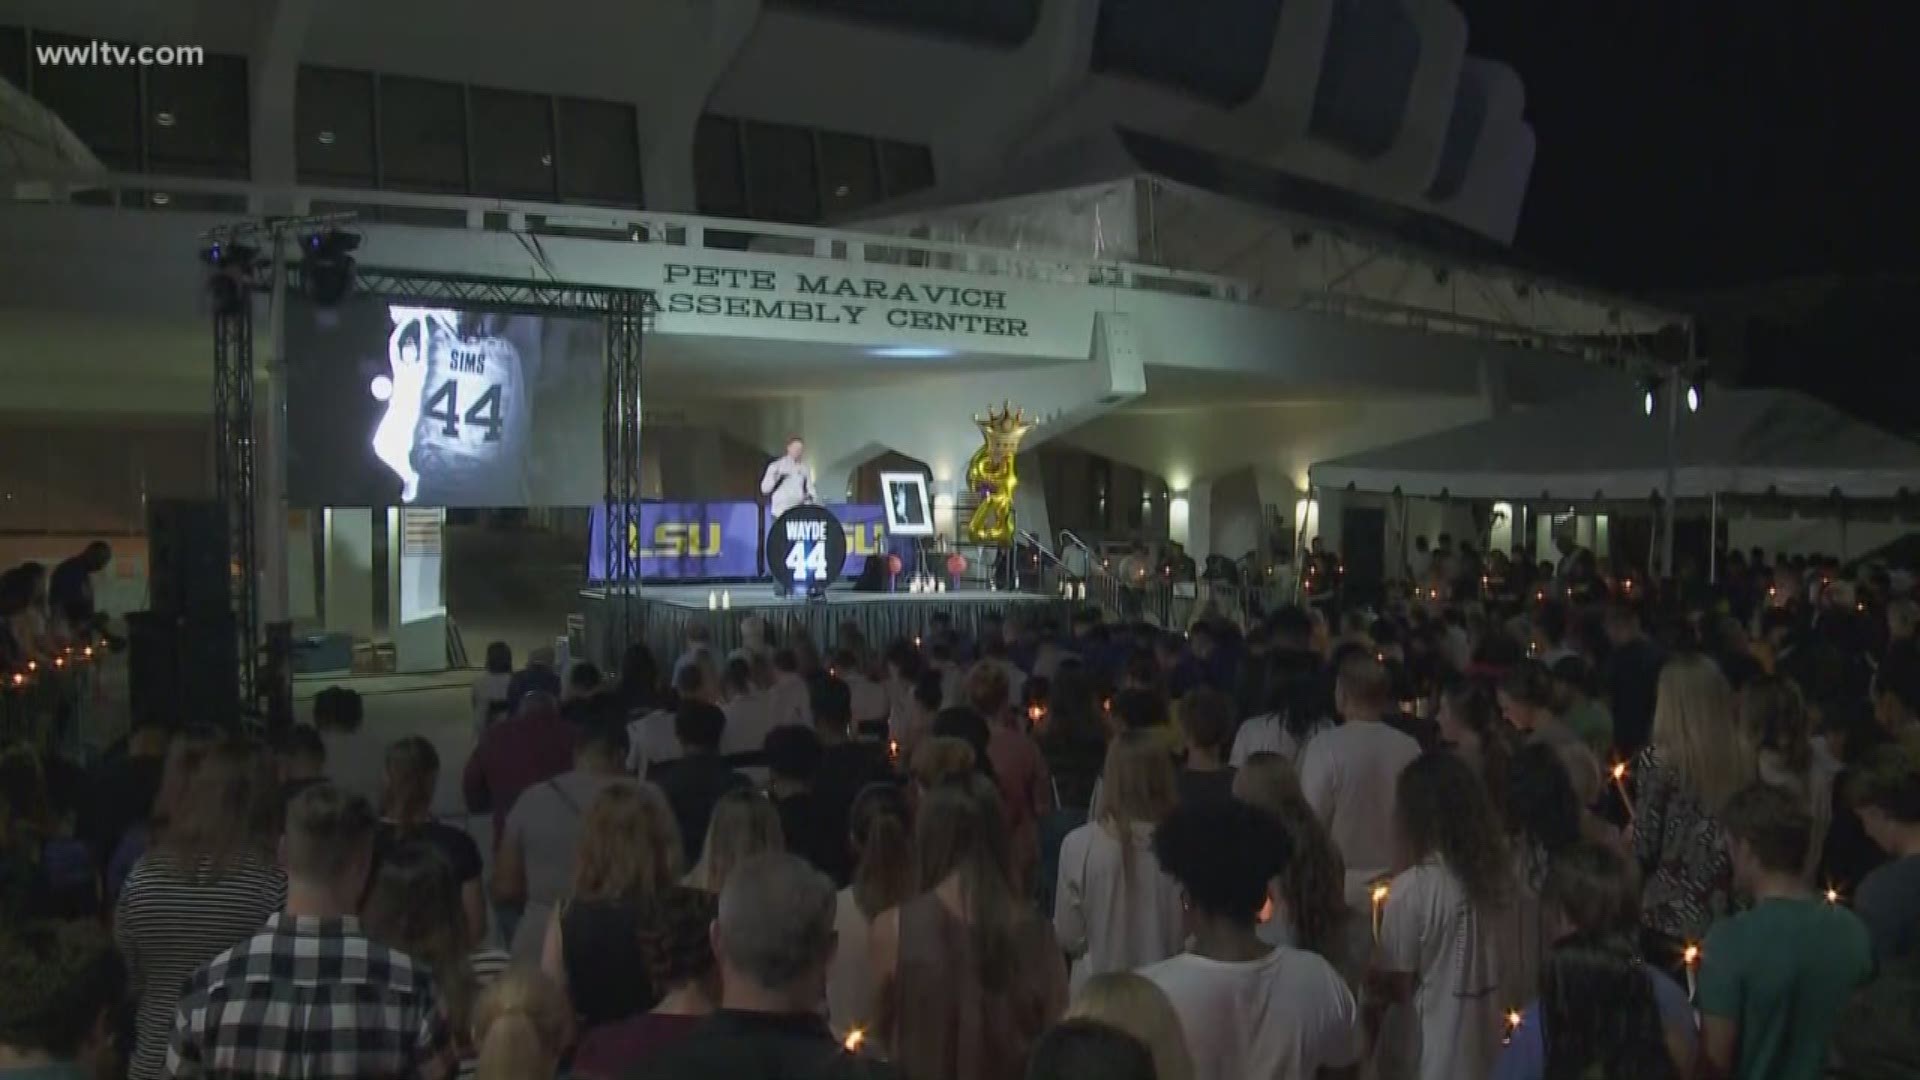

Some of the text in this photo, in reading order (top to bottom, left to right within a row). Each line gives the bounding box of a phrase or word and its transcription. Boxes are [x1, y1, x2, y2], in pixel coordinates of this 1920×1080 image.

[663, 263, 1007, 309] PETE MARAVICH
[886, 307, 1029, 337] CENTER
[450, 348, 486, 375] SIMS
[423, 379, 503, 441] 44
[785, 520, 828, 540] WAYDE
[785, 540, 828, 580] 44
